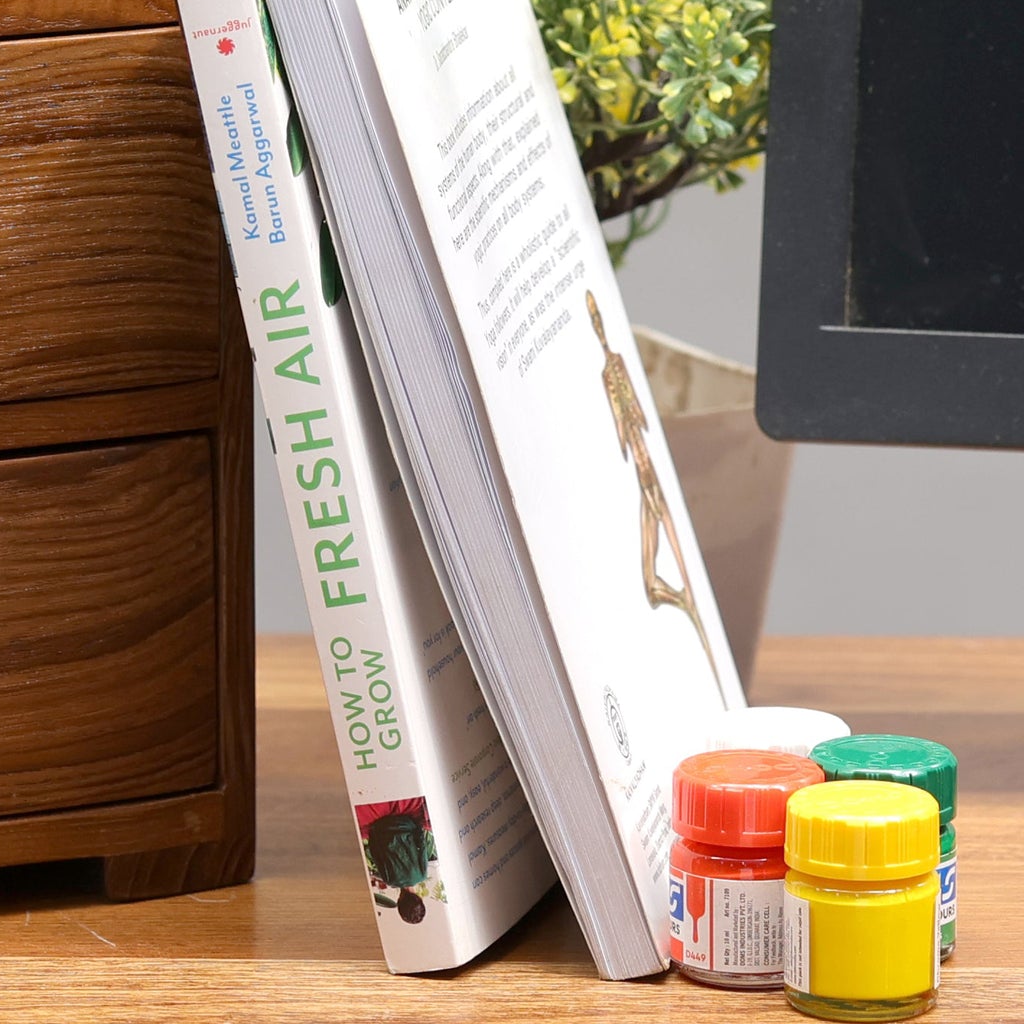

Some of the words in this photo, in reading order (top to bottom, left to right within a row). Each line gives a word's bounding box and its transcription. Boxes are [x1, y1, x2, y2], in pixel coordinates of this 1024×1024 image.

[192, 17, 251, 40] juggernaut
[465, 88, 493, 122] information
[492, 74, 510, 97] about
[217, 95, 246, 172] Meattle
[236, 82, 273, 178] Aggarwal
[437, 169, 457, 198] systems
[498, 93, 524, 125] structural
[446, 186, 468, 221] functional
[476, 158, 493, 181] Along
[515, 112, 541, 143] explained
[487, 168, 517, 205] mechanisms
[516, 157, 528, 176] and
[232, 176, 260, 240] Kamal
[264, 184, 286, 244] Barun
[495, 216, 504, 232] on
[506, 196, 523, 218] body
[518, 279, 532, 298] help
[530, 259, 552, 287] develop
[534, 299, 546, 318] was
[543, 290, 555, 307] the
[554, 271, 573, 297] intense
[259, 279, 321, 386] AIR
[520, 342, 536, 372] Swami
[284, 408, 368, 608] FRESH
[330, 636, 358, 686] TO
[427, 654, 455, 683] household
[360, 649, 402, 750] GROW
[340, 692, 377, 772] HOW
[458, 823, 470, 844] and
[469, 808, 491, 832] research
[467, 844, 487, 866] Kamal
[686, 949, 706, 962] D449
